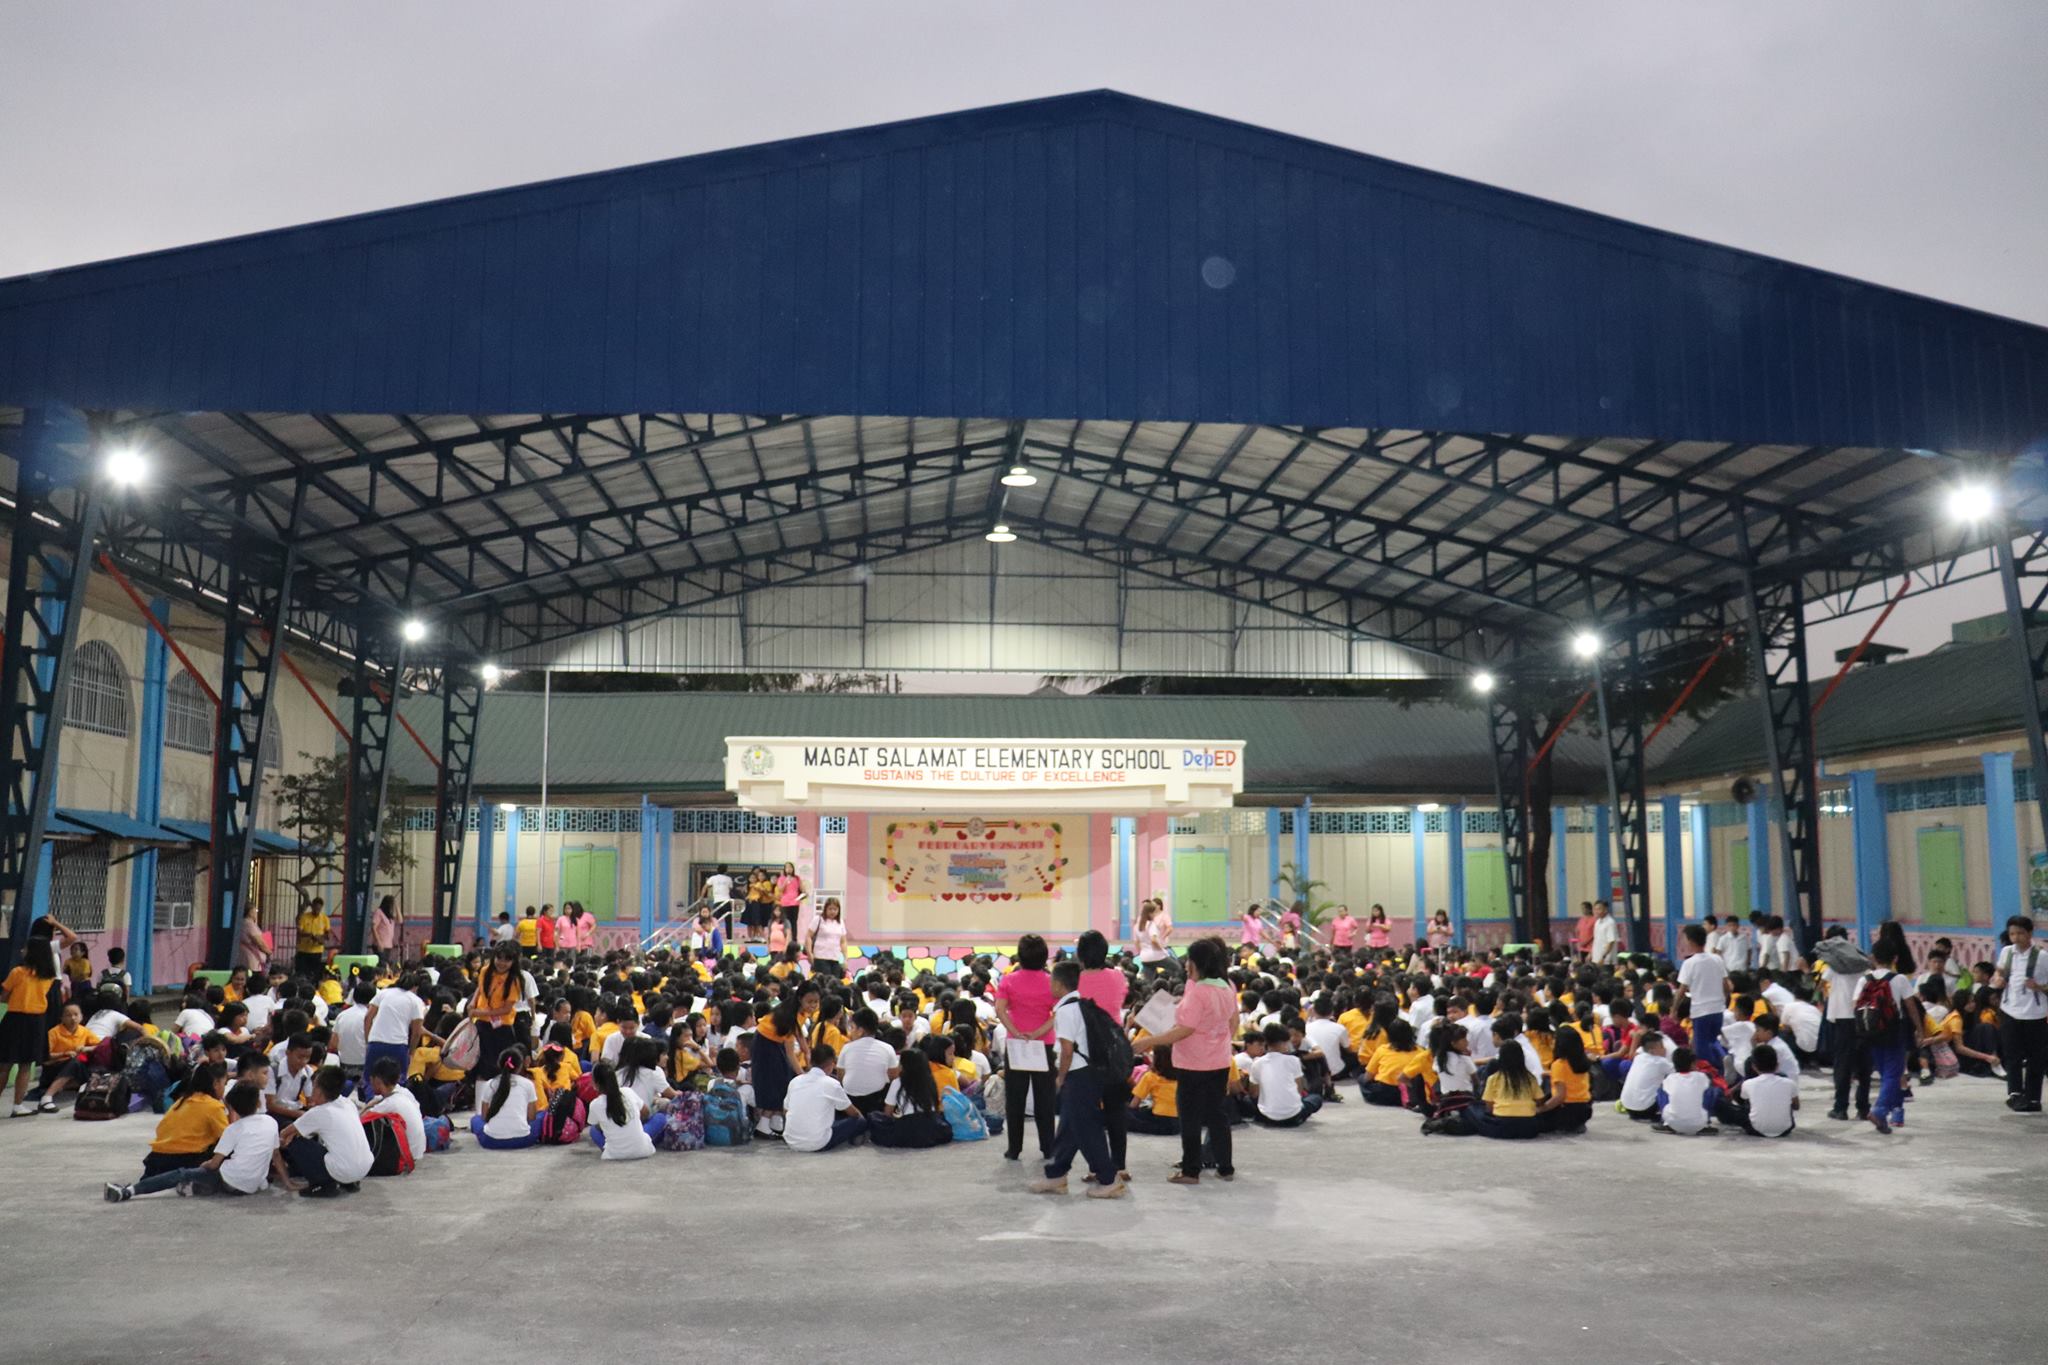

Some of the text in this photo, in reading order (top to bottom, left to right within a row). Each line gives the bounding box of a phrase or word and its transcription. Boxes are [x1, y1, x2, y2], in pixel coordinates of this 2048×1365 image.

[804, 746, 1172, 770] MAGAT SALAMAT ELEMENTARY SCHOOL
[1183, 748, 1236, 771] DepED
[863, 769, 1126, 783] SUSTAINS THE CULTURE OF EXCELLENCE
